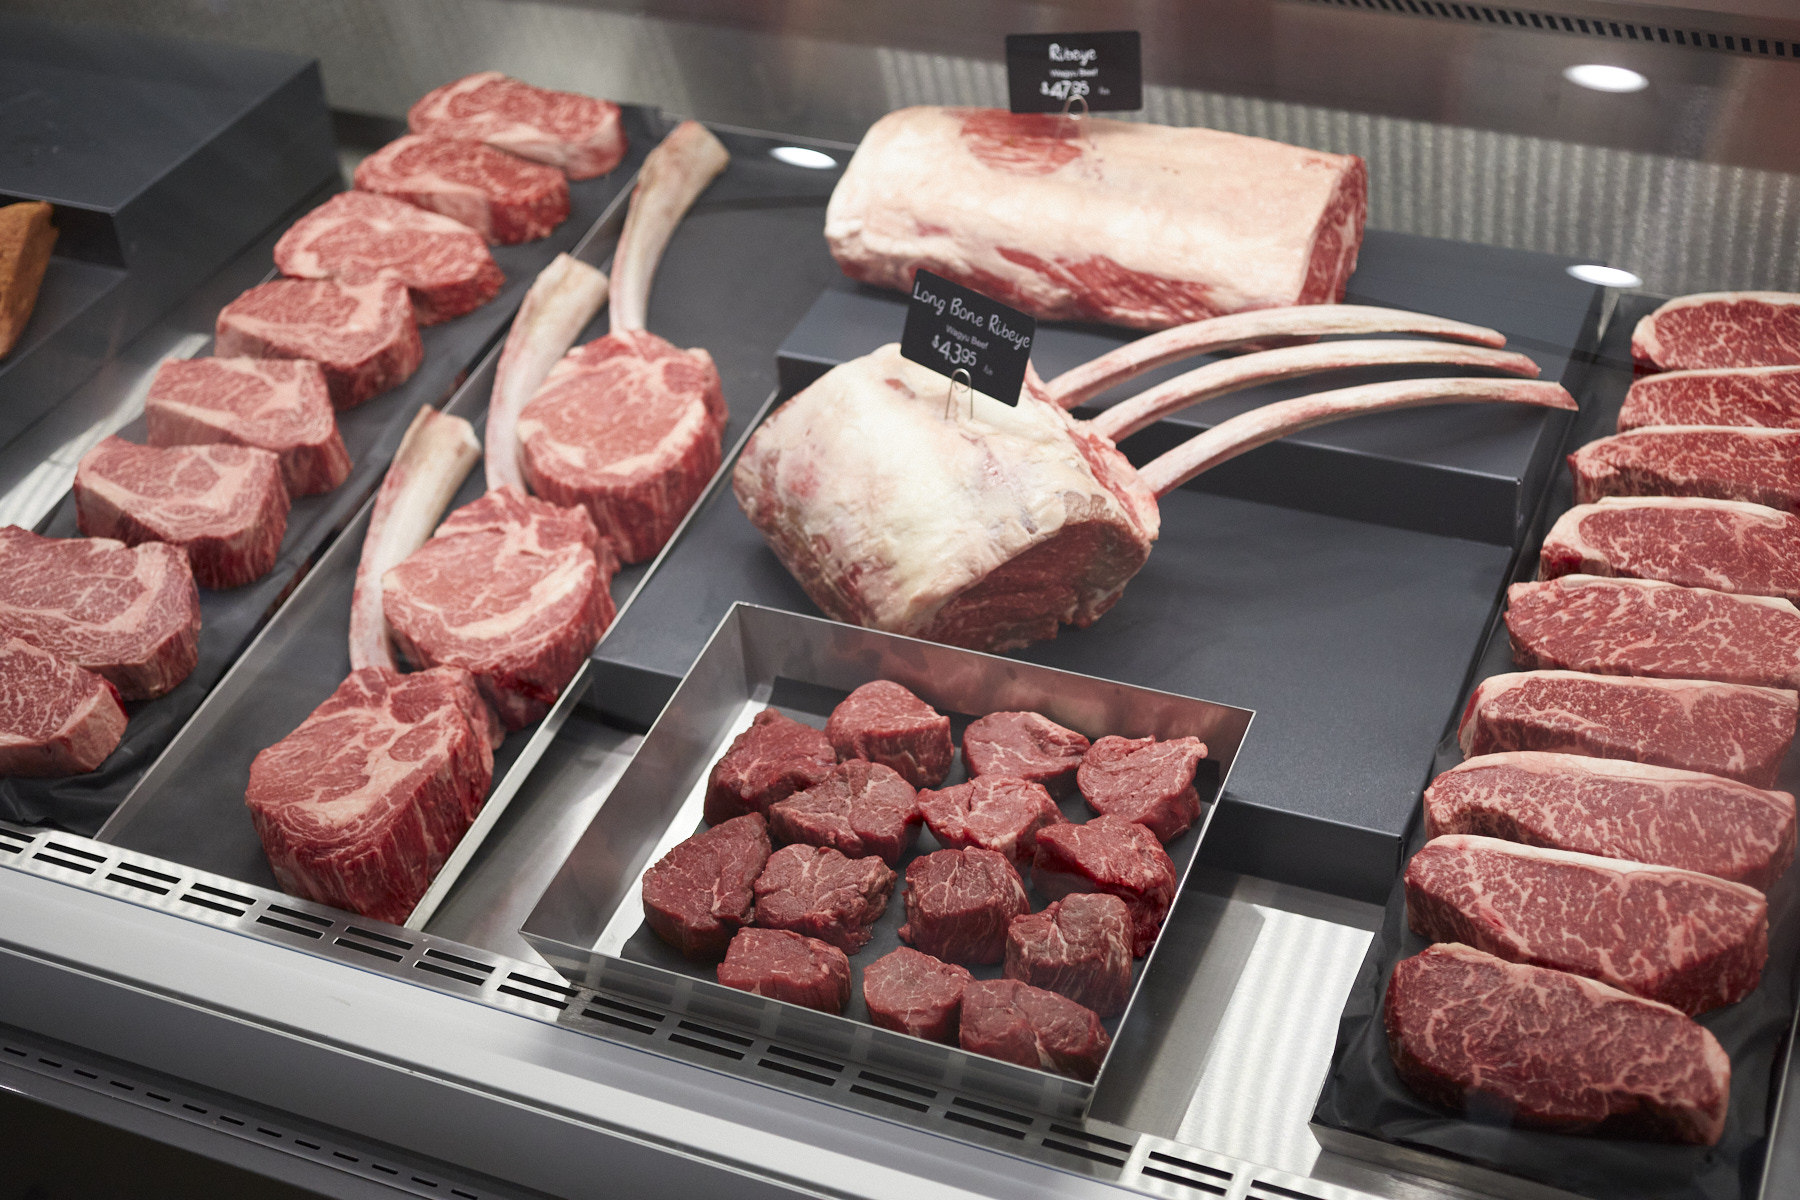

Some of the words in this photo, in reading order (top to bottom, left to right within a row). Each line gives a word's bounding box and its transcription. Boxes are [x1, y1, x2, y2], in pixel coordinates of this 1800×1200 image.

[1048, 43, 1097, 66] Ribeye
[913, 281, 946, 316] Long
[950, 298, 984, 327] Bone
[988, 314, 1031, 351] Ribeye
[931, 334, 977, 366] $4395
[946, 324, 971, 342] Wagyu
[971, 336, 989, 350] Beef
